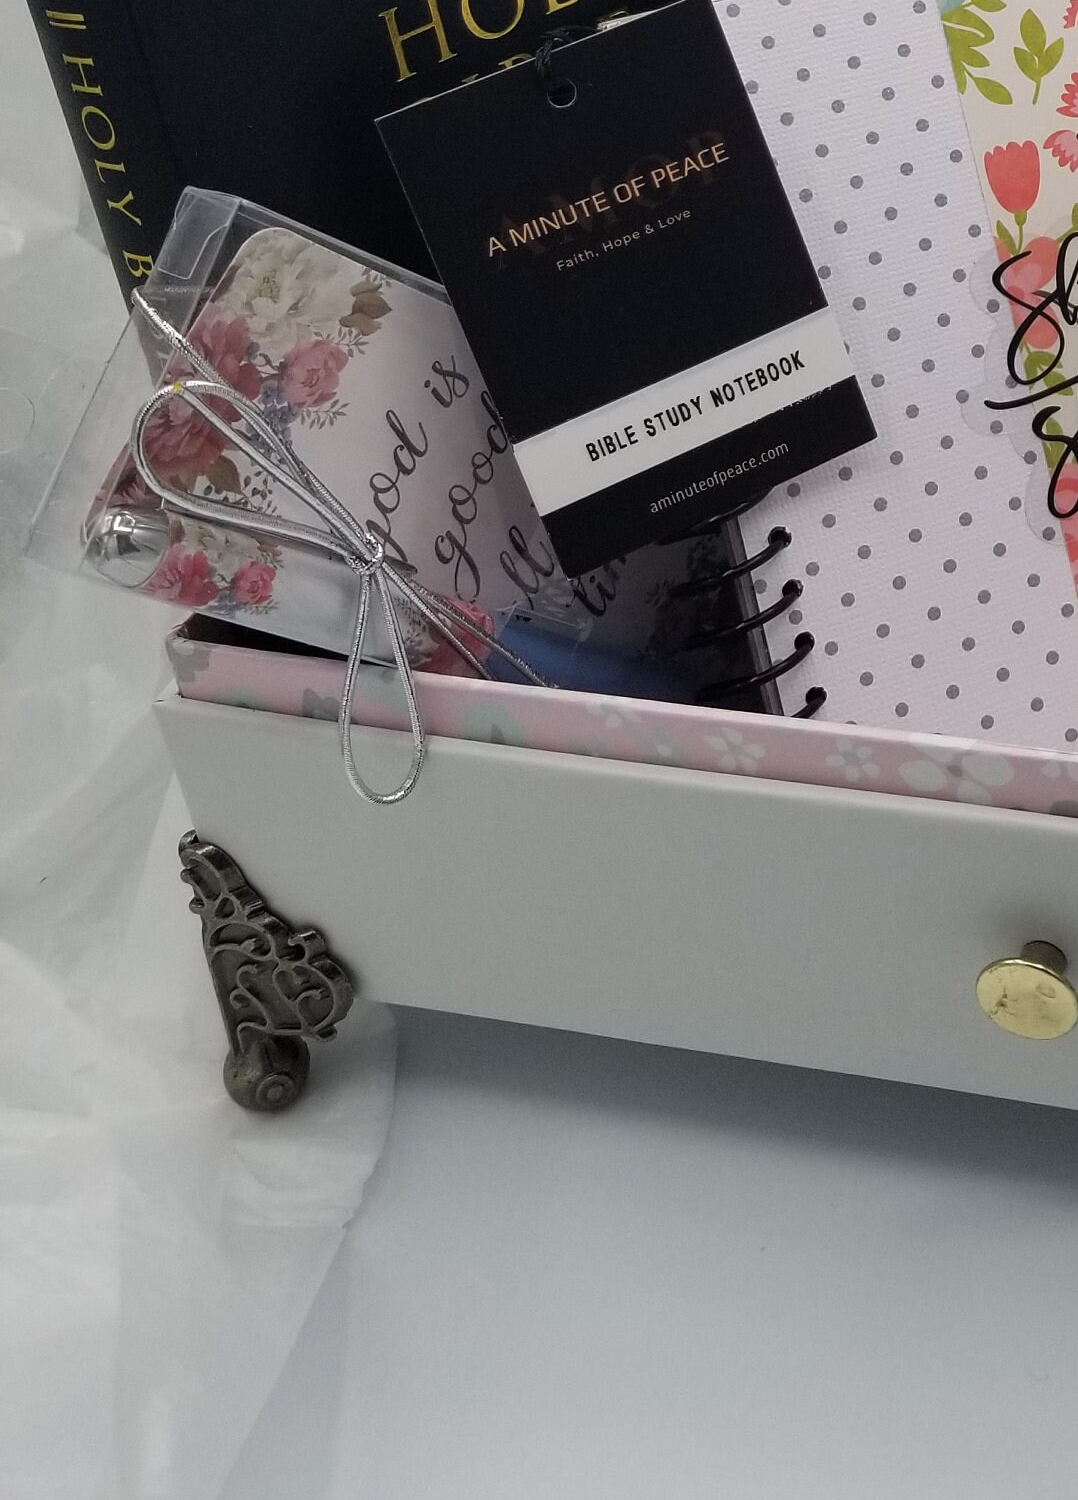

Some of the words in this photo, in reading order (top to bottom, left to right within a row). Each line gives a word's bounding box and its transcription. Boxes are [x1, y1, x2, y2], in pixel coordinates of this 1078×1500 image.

[62, 53, 142, 227] HOLY
[488, 237, 508, 257] A
[508, 191, 611, 247] MINUTE
[613, 176, 647, 203] OF
[651, 142, 730, 189] PEACE
[556, 249, 600, 271] Faith,
[602, 229, 641, 252] Hope
[645, 224, 655, 235] &
[657, 209, 692, 229] Love
[424, 355, 470, 408] is
[585, 425, 639, 462] BIBLE
[643, 396, 703, 437] STUDY
[709, 350, 806, 408] NOTEBOOK
[649, 441, 790, 514] aminuteofpeace.com
[500, 525, 554, 611] ll
